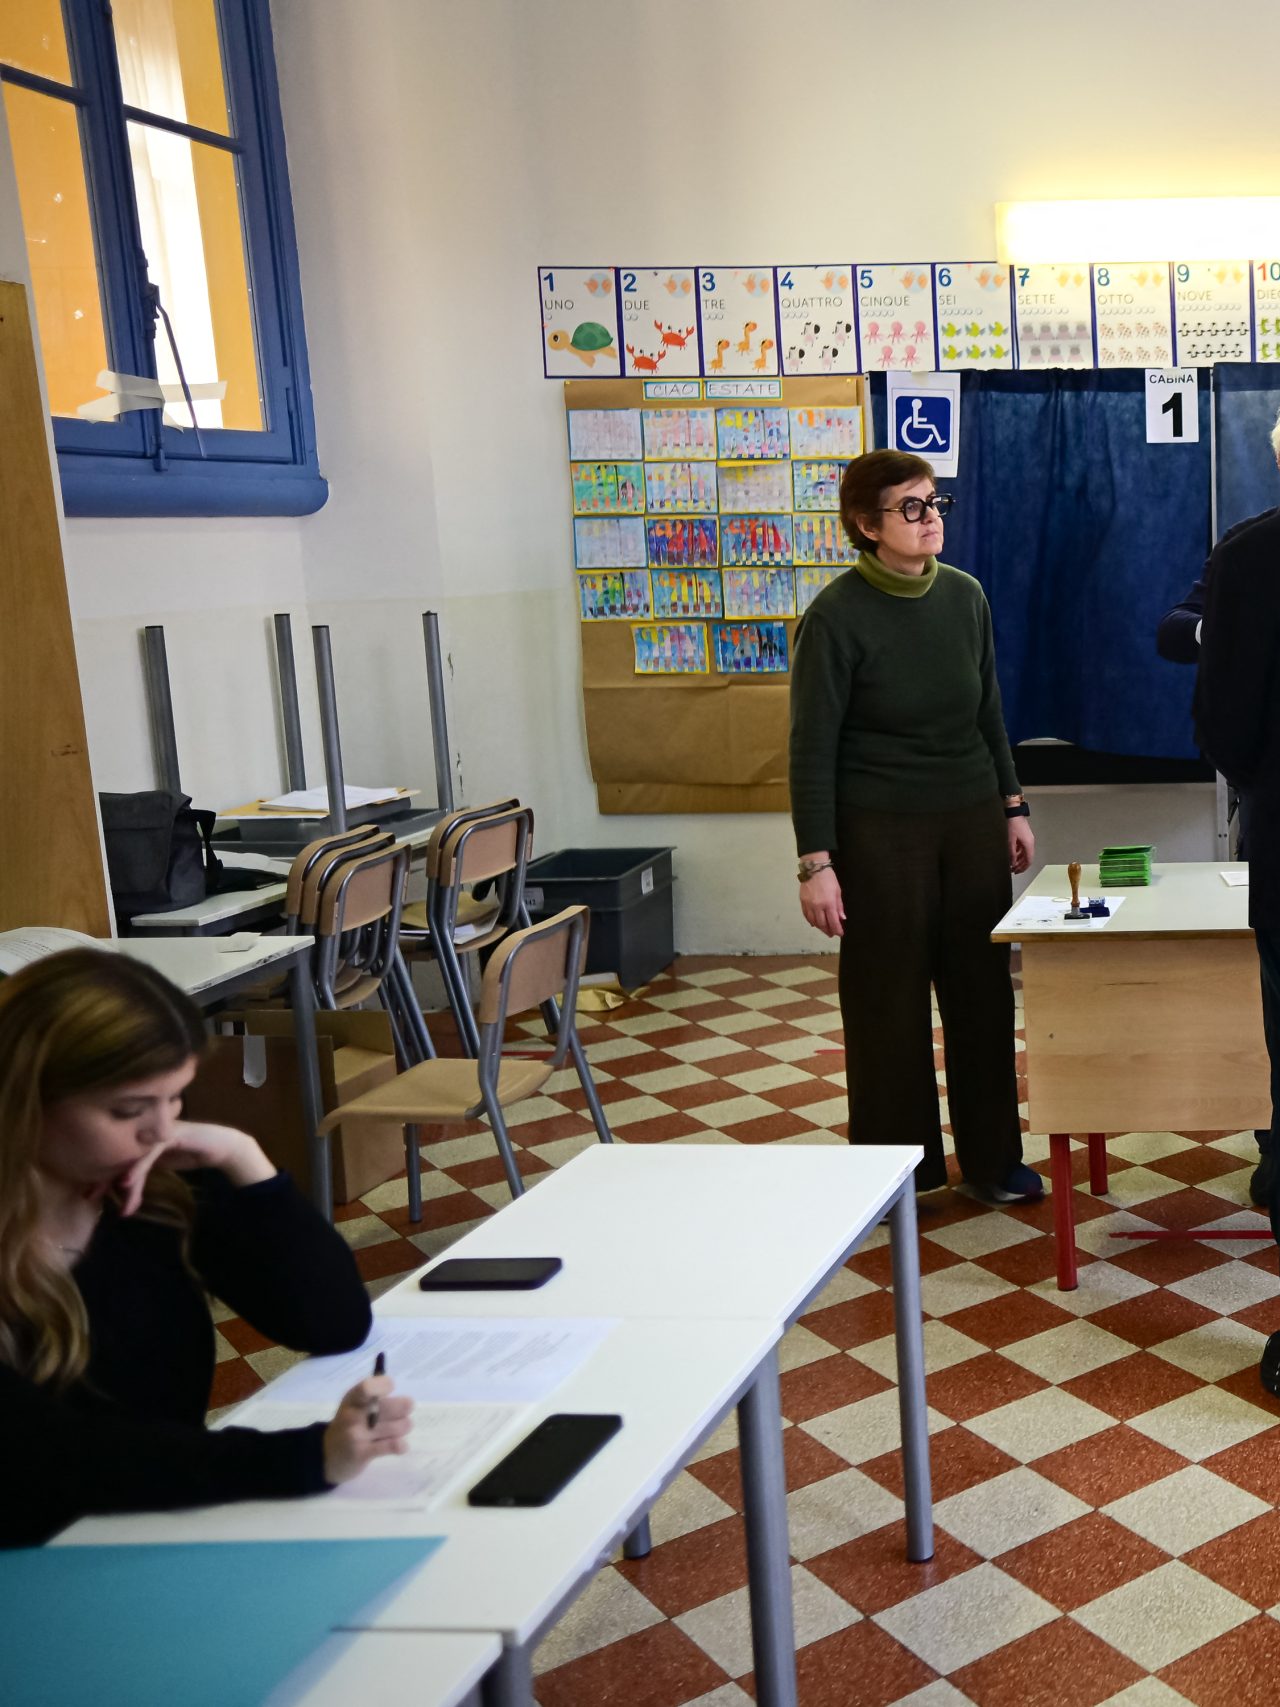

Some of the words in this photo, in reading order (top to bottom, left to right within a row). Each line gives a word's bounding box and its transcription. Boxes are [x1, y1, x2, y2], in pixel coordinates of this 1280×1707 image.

[780, 271, 794, 290] 4
[860, 270, 873, 288] 5
[938, 268, 952, 288] 6
[1017, 268, 1030, 287] 7
[1097, 268, 1110, 286] 8
[1177, 264, 1189, 283] 9
[543, 272, 554, 292] 1
[623, 273, 637, 292] 2
[702, 272, 716, 291] 3
[781, 297, 843, 308] QUATTRO
[860, 296, 910, 307] CINQUE
[938, 295, 956, 305] SEI
[1018, 294, 1056, 305] SETTE
[1097, 294, 1134, 305] OTTO
[1177, 290, 1212, 301] NOVE
[544, 299, 574, 310] UNO
[624, 300, 649, 310] DUE
[703, 299, 725, 309] TRE
[1149, 374, 1194, 383] CABINA
[653, 383, 694, 397] CIAO
[708, 383, 777, 396] ESTATE
[1162, 392, 1183, 437] 1
